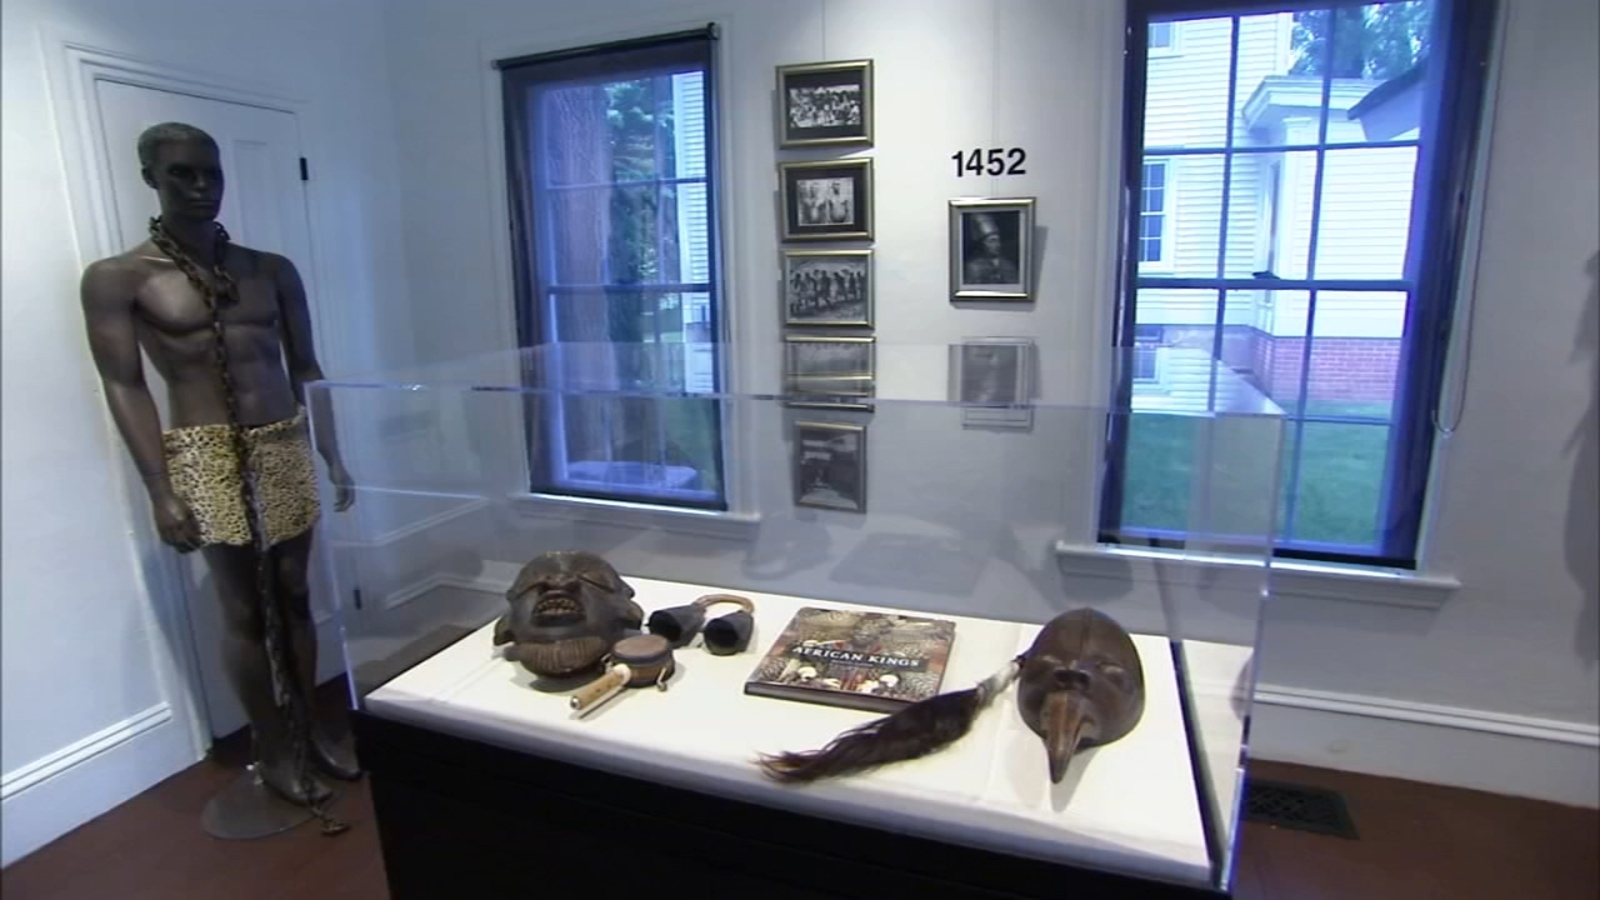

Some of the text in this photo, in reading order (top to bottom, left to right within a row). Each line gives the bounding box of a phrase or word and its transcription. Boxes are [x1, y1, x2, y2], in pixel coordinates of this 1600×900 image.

[951, 147, 1026, 177] 1452
[792, 646, 864, 661] AFRICAN
[867, 655, 920, 667] KINGS
